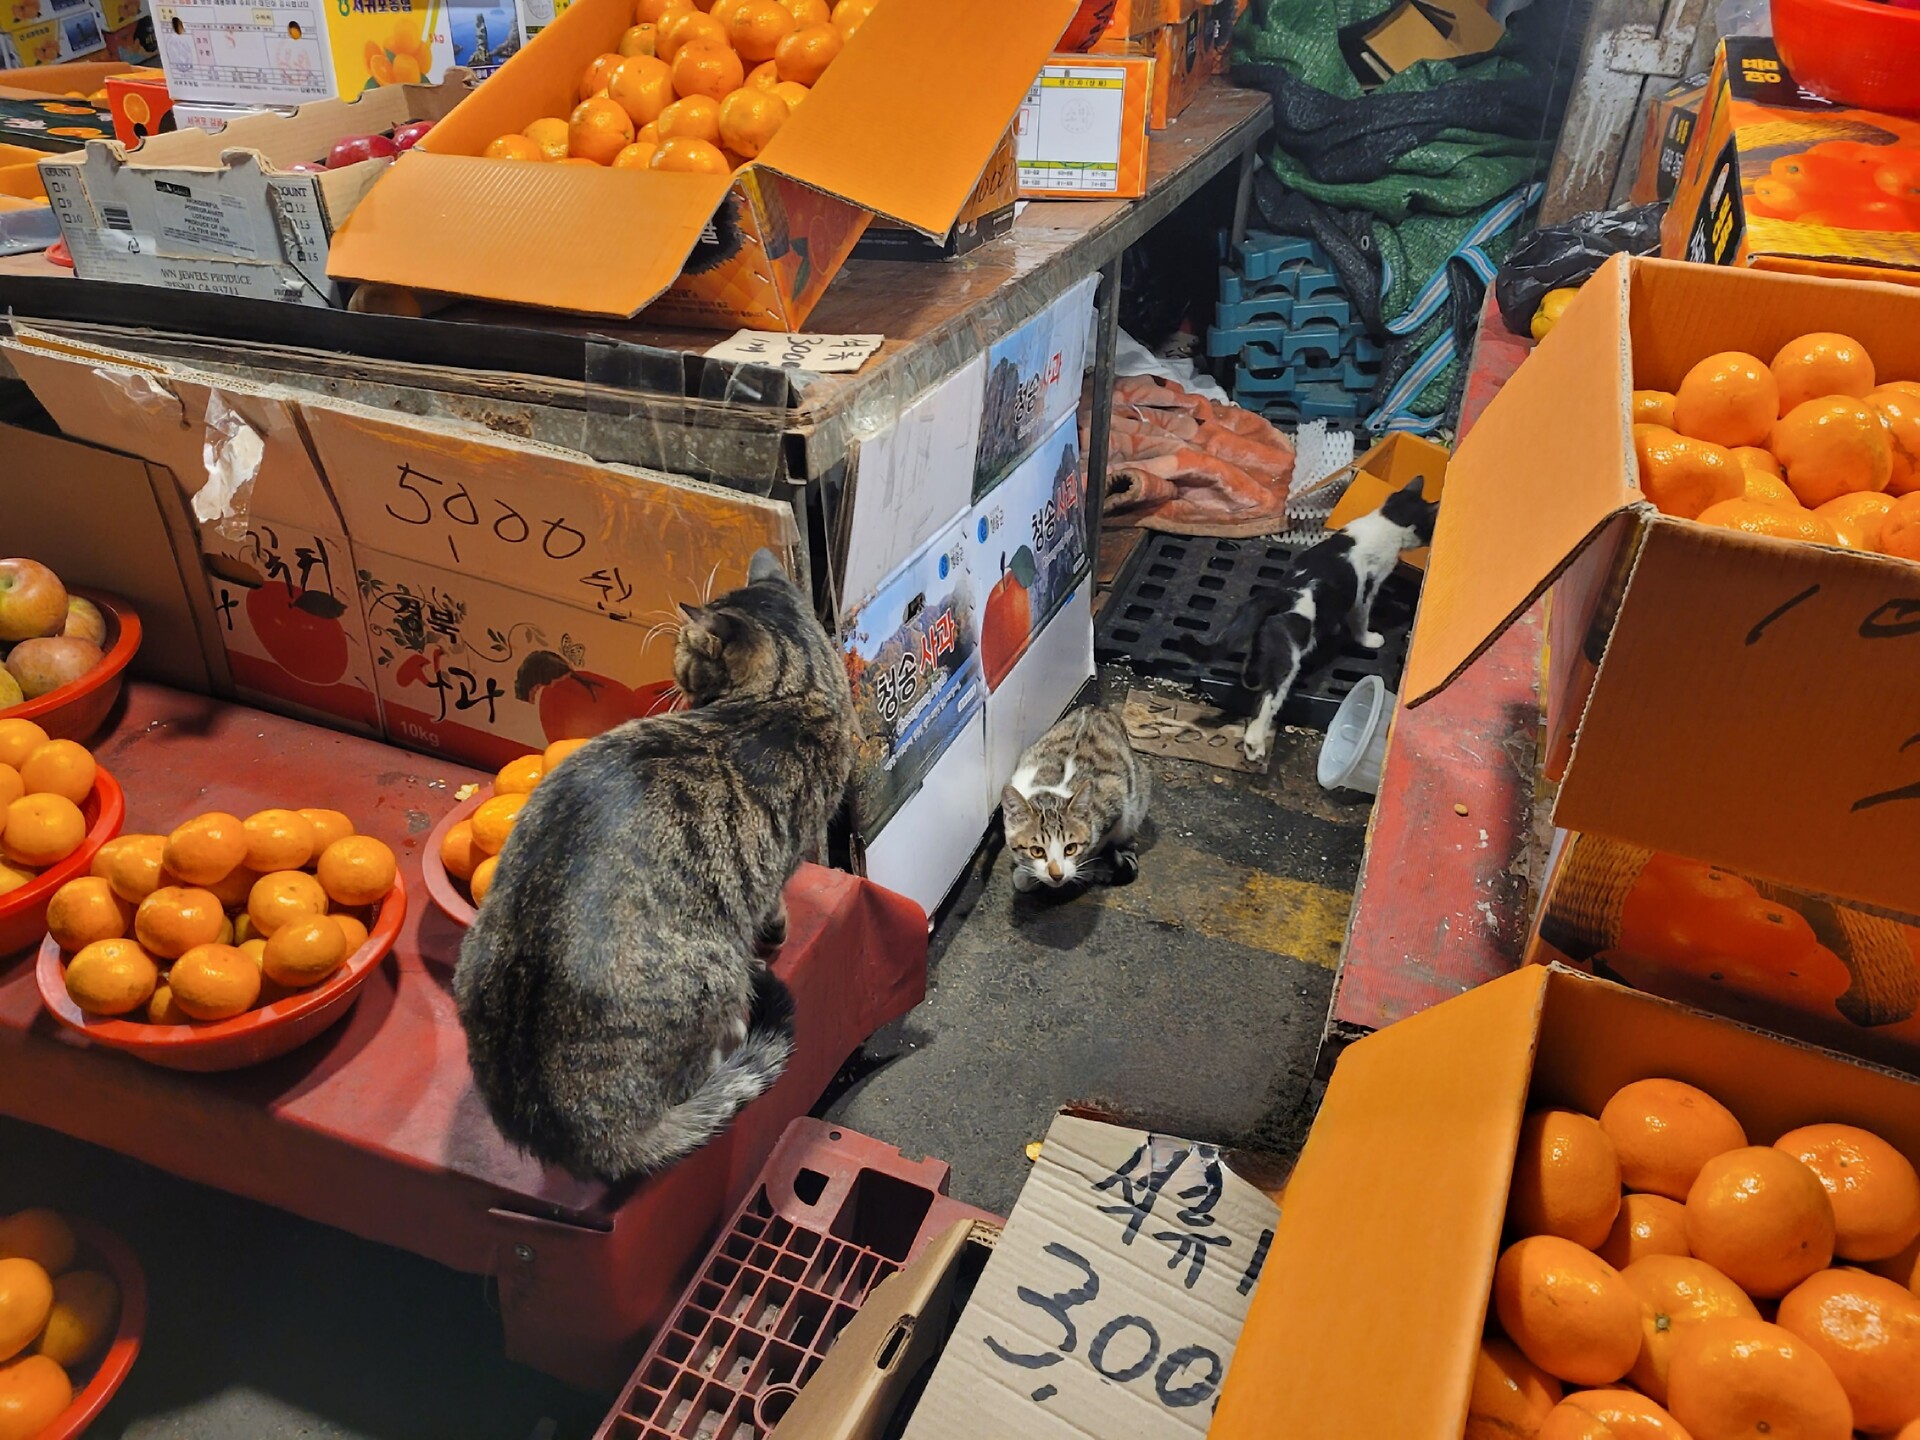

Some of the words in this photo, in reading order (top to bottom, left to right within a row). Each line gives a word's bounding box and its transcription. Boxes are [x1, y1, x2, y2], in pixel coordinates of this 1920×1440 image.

[210, 273, 252, 286] PRODUCE
[1031, 499, 1056, 554] 청송
[1055, 470, 1078, 521] 사과
[876, 652, 917, 722] 청송
[919, 608, 956, 676] 사과
[399, 719, 441, 748] 10kg
